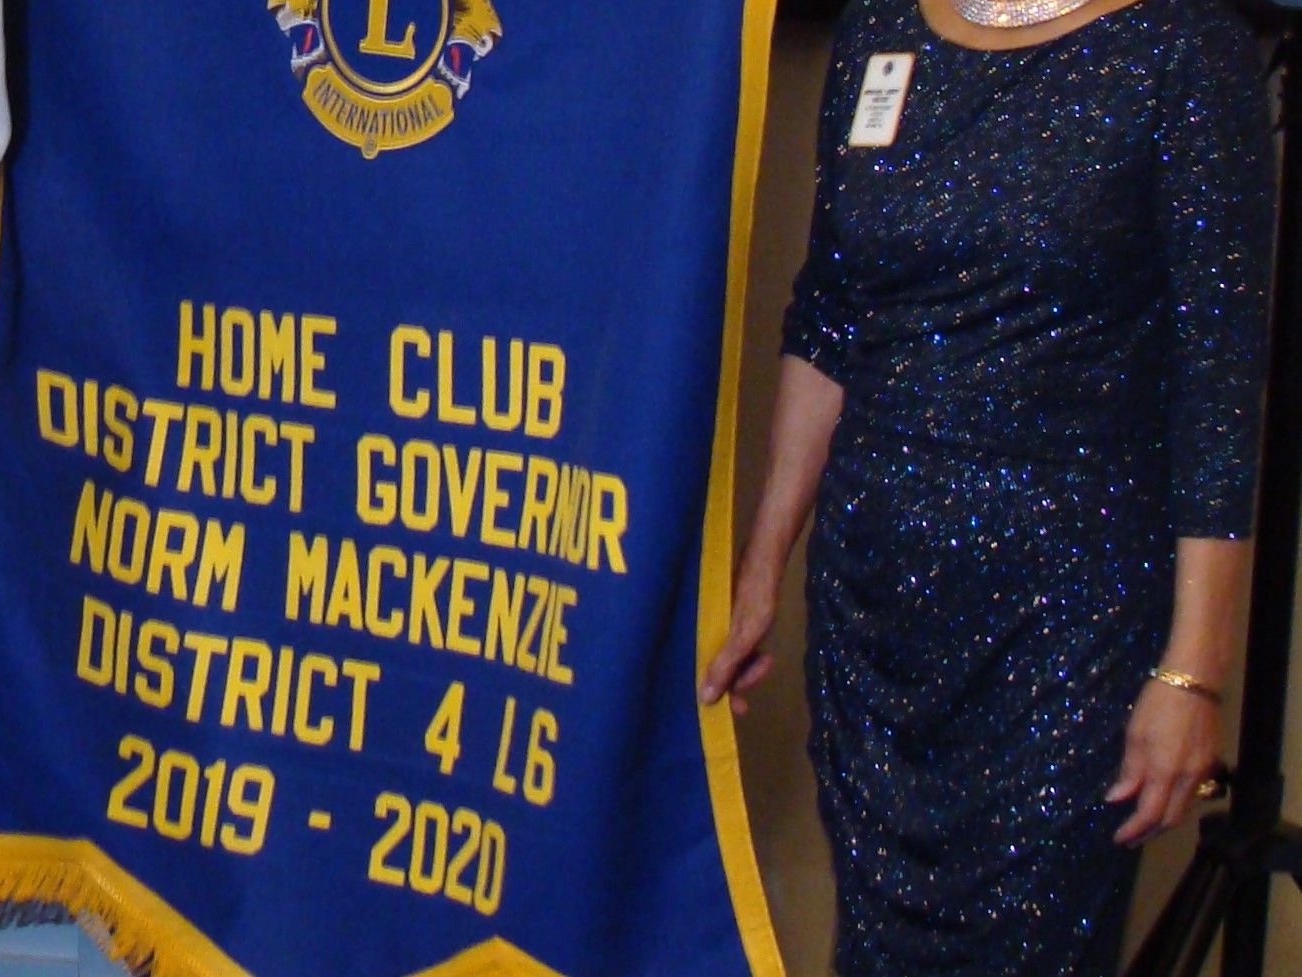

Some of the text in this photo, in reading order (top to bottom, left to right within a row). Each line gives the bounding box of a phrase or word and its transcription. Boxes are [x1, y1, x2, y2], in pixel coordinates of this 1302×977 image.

[313, 77, 445, 138] INTERNATIONAL
[177, 300, 566, 438] HOME CLUB
[36, 369, 629, 573] DISTRICT GOVERNOR
[70, 480, 578, 685] NORM MACKENZIE
[77, 595, 559, 805] DISTRICT 4 L6
[106, 734, 507, 916] 2019 - 2020
